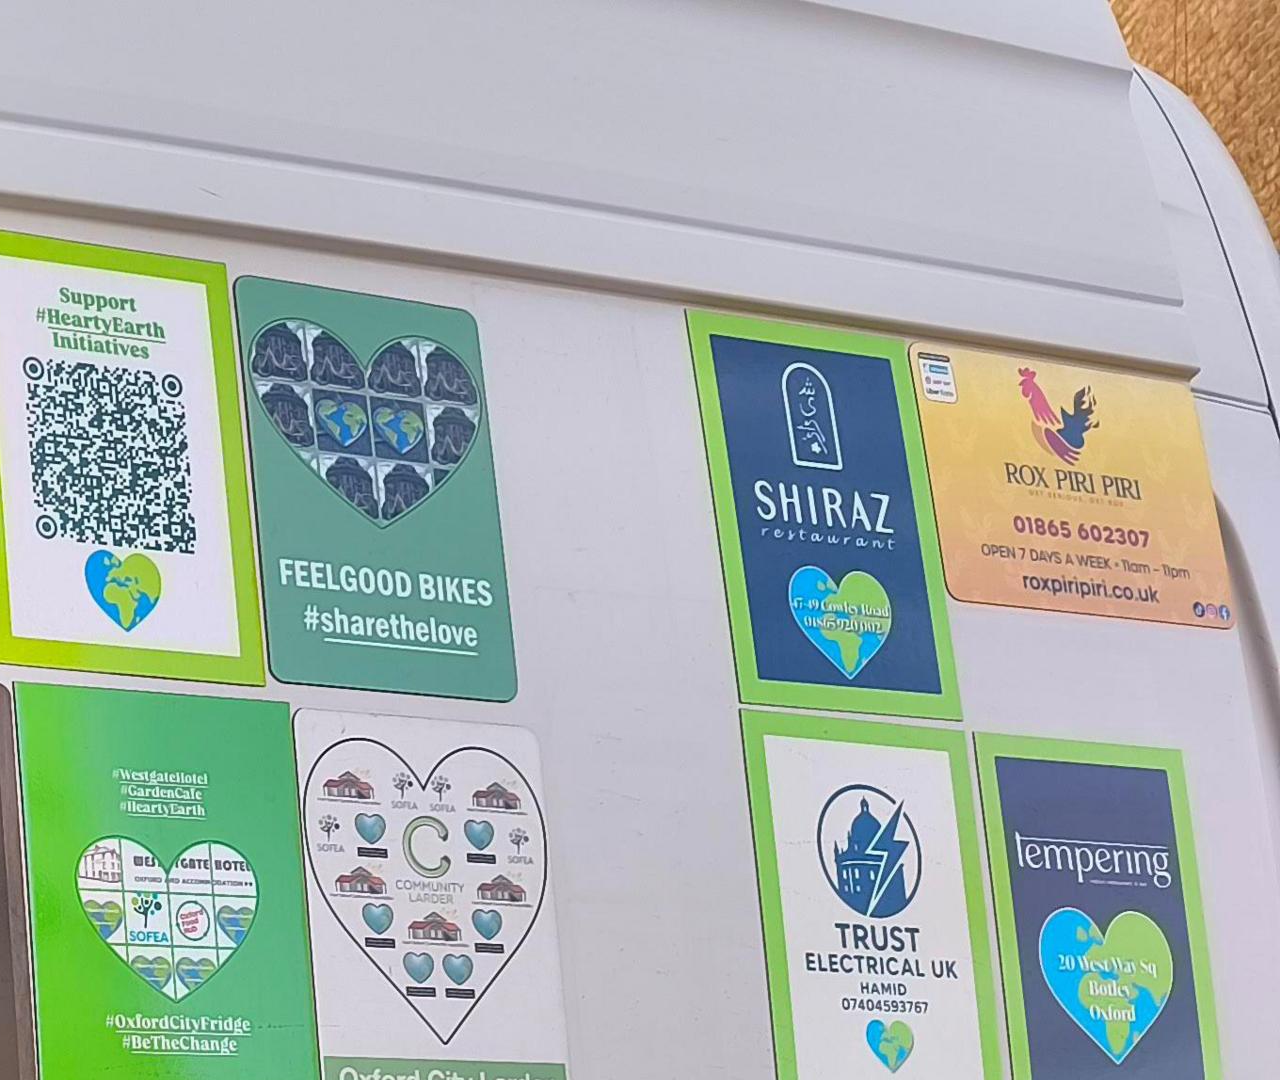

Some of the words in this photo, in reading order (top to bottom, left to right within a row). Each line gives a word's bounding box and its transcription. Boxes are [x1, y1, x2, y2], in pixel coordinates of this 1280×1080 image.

[59, 287, 137, 312] Support
[37, 307, 165, 339] #HeartyEarth
[52, 332, 150, 359] Initiatives
[1005, 463, 1049, 488] ROX
[1055, 469, 1096, 494] PIRI
[1101, 475, 1142, 500] PIRI
[754, 480, 894, 533] SHIRAZ
[761, 527, 896, 550] restaurant
[1013, 515, 1071, 538] 01865
[1078, 523, 1149, 548] 602307
[981, 543, 1016, 559] OPEN
[1018, 548, 1026, 560] 7
[1031, 549, 1062, 564] DAYS
[1065, 553, 1074, 565] A
[1075, 554, 1111, 570] WEEK
[279, 558, 412, 597] FEELGOOD
[419, 573, 493, 606] BIKES
[1023, 575, 1160, 604] roxpiripiri.co.uk
[304, 604, 478, 647] #sharethelove
[120, 785, 203, 800] #GardenCafe
[396, 879, 464, 893] COMMUNITY
[409, 893, 453, 904] LARDER
[129, 931, 168, 942] SOFEA
[835, 923, 920, 952] TRUST
[805, 952, 925, 977] ELECTRICAL
[931, 960, 958, 979] UK
[1058, 954, 1076, 971] 20
[860, 982, 907, 996] HAMID
[842, 998, 928, 1014] 07404593767
[1090, 1004, 1136, 1022] Oxford
[106, 1013, 251, 1034] #OxfordCityFridge
[123, 1035, 238, 1054] #BeTheChange
